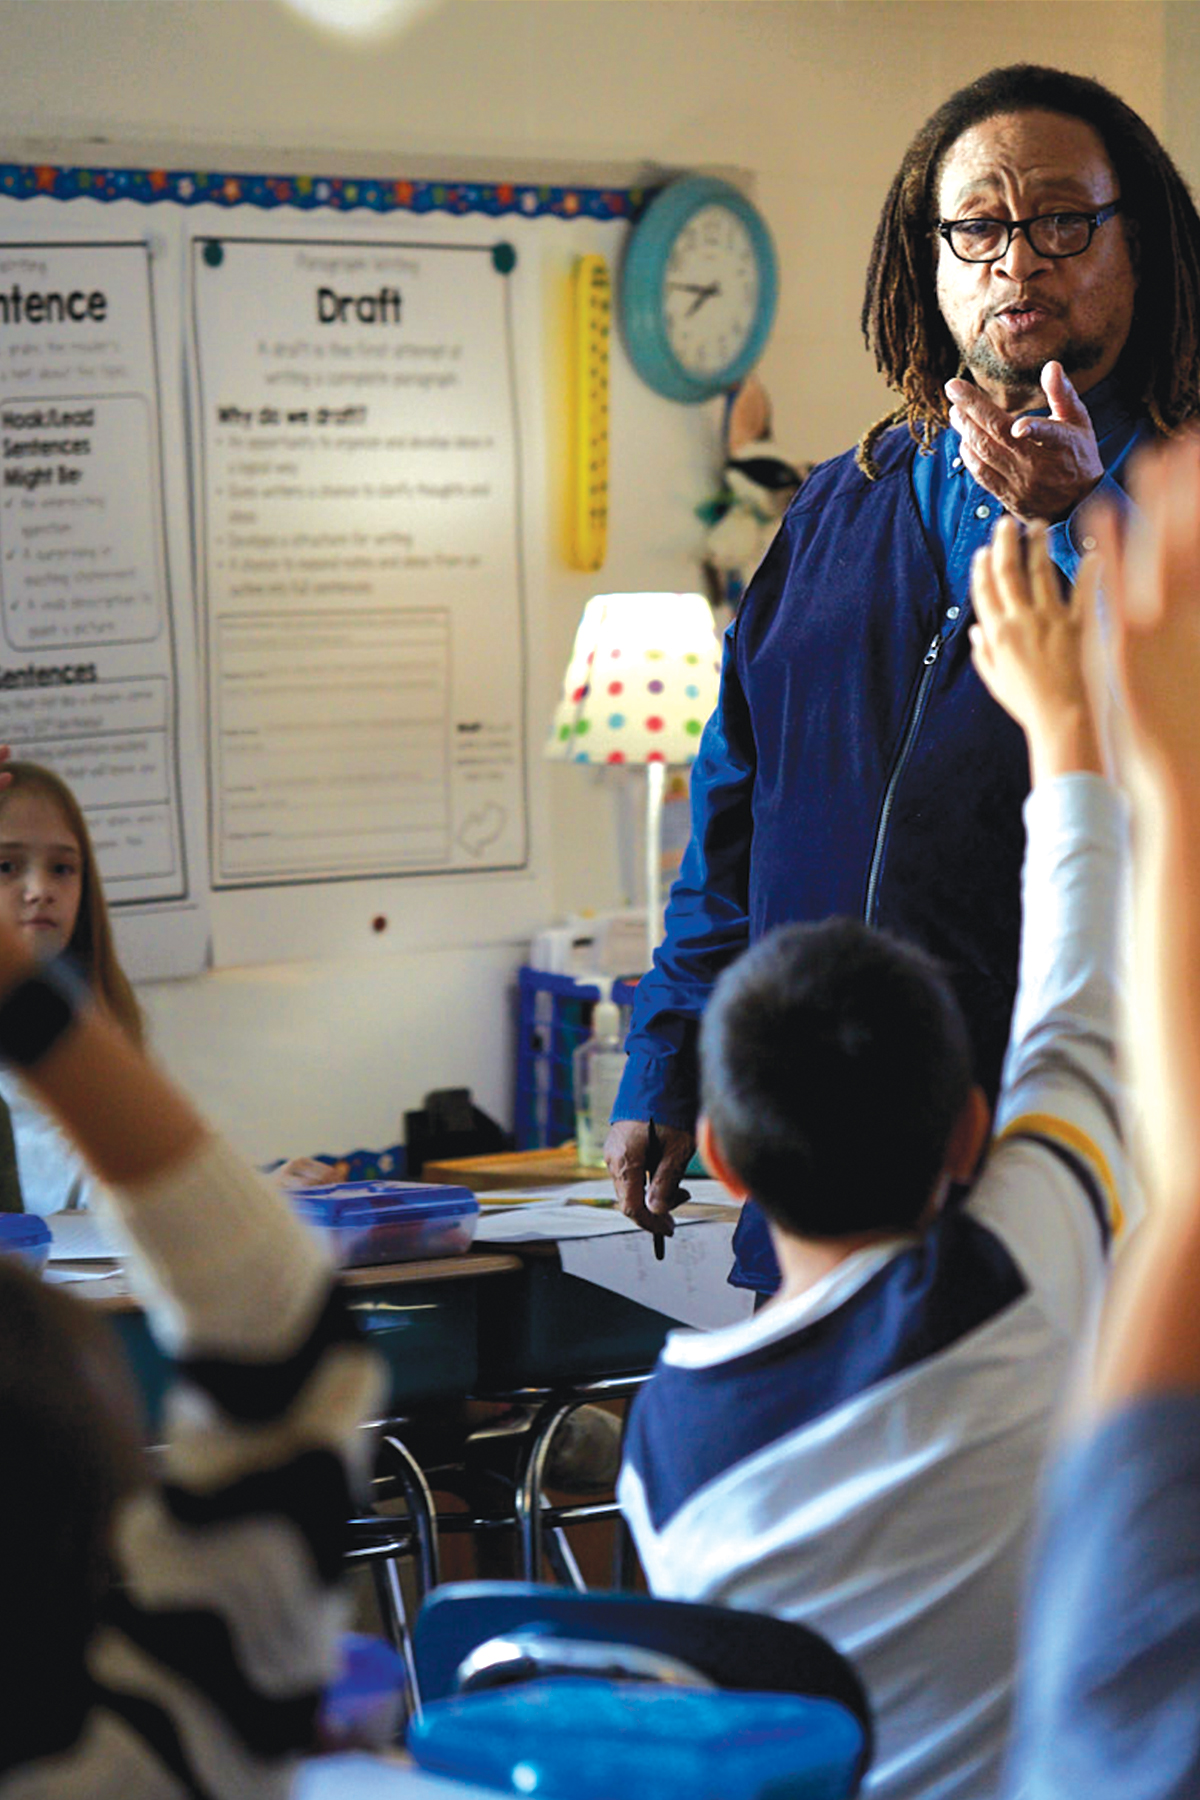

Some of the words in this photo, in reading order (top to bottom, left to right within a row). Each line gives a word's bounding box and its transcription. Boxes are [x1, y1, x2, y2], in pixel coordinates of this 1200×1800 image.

[317, 286, 403, 326] Draft
[219, 405, 251, 431] Why
[259, 405, 280, 427] do
[287, 410, 309, 426] we
[3, 436, 91, 459] Sentences
[4, 466, 53, 491] Might
[0, 662, 98, 691] entences
